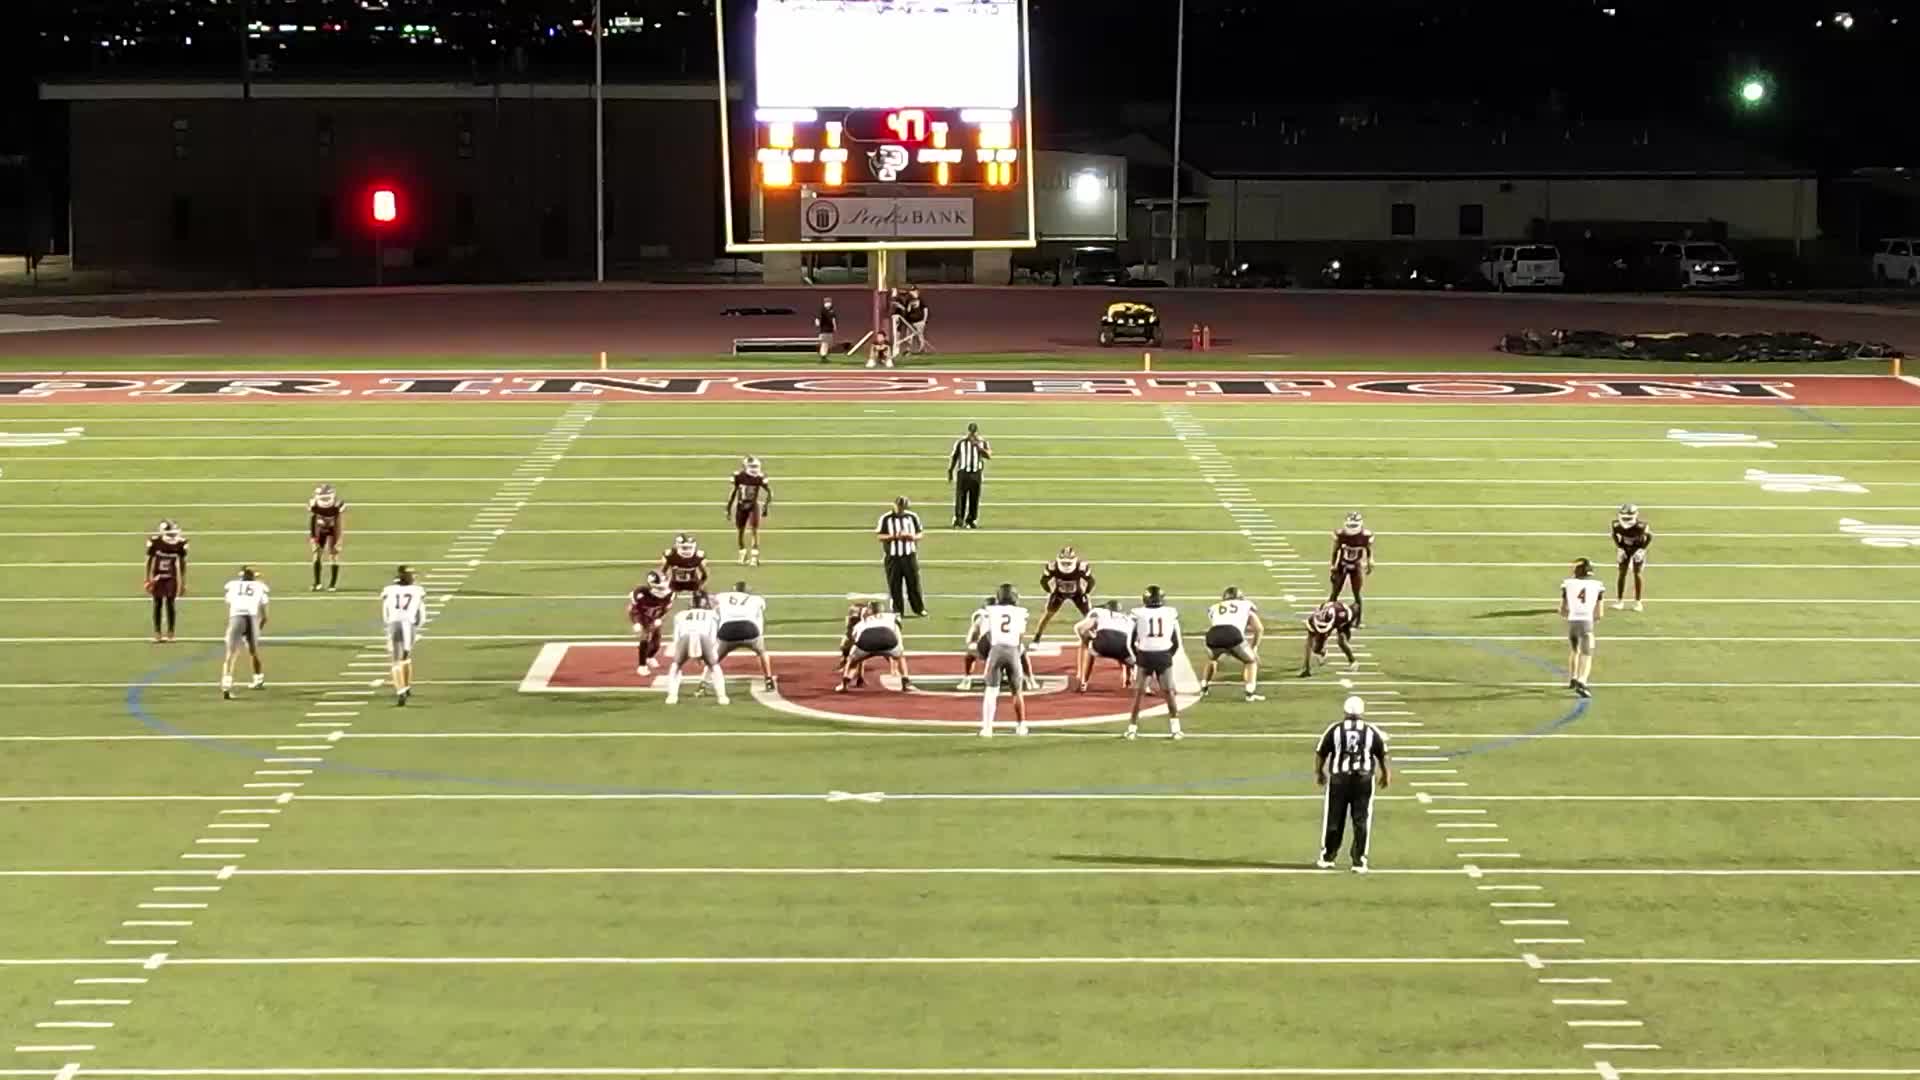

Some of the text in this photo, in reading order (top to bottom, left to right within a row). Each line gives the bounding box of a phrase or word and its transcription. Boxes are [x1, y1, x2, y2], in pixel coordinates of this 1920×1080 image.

[912, 210, 966, 225] BANK
[0, 378, 1797, 396] PRINCETON
[395, 593, 412, 610] 17
[1577, 587, 1586, 604] 4
[1000, 614, 1012, 633] 2
[1147, 617, 1163, 637] 11
[1346, 730, 1360, 753] R
